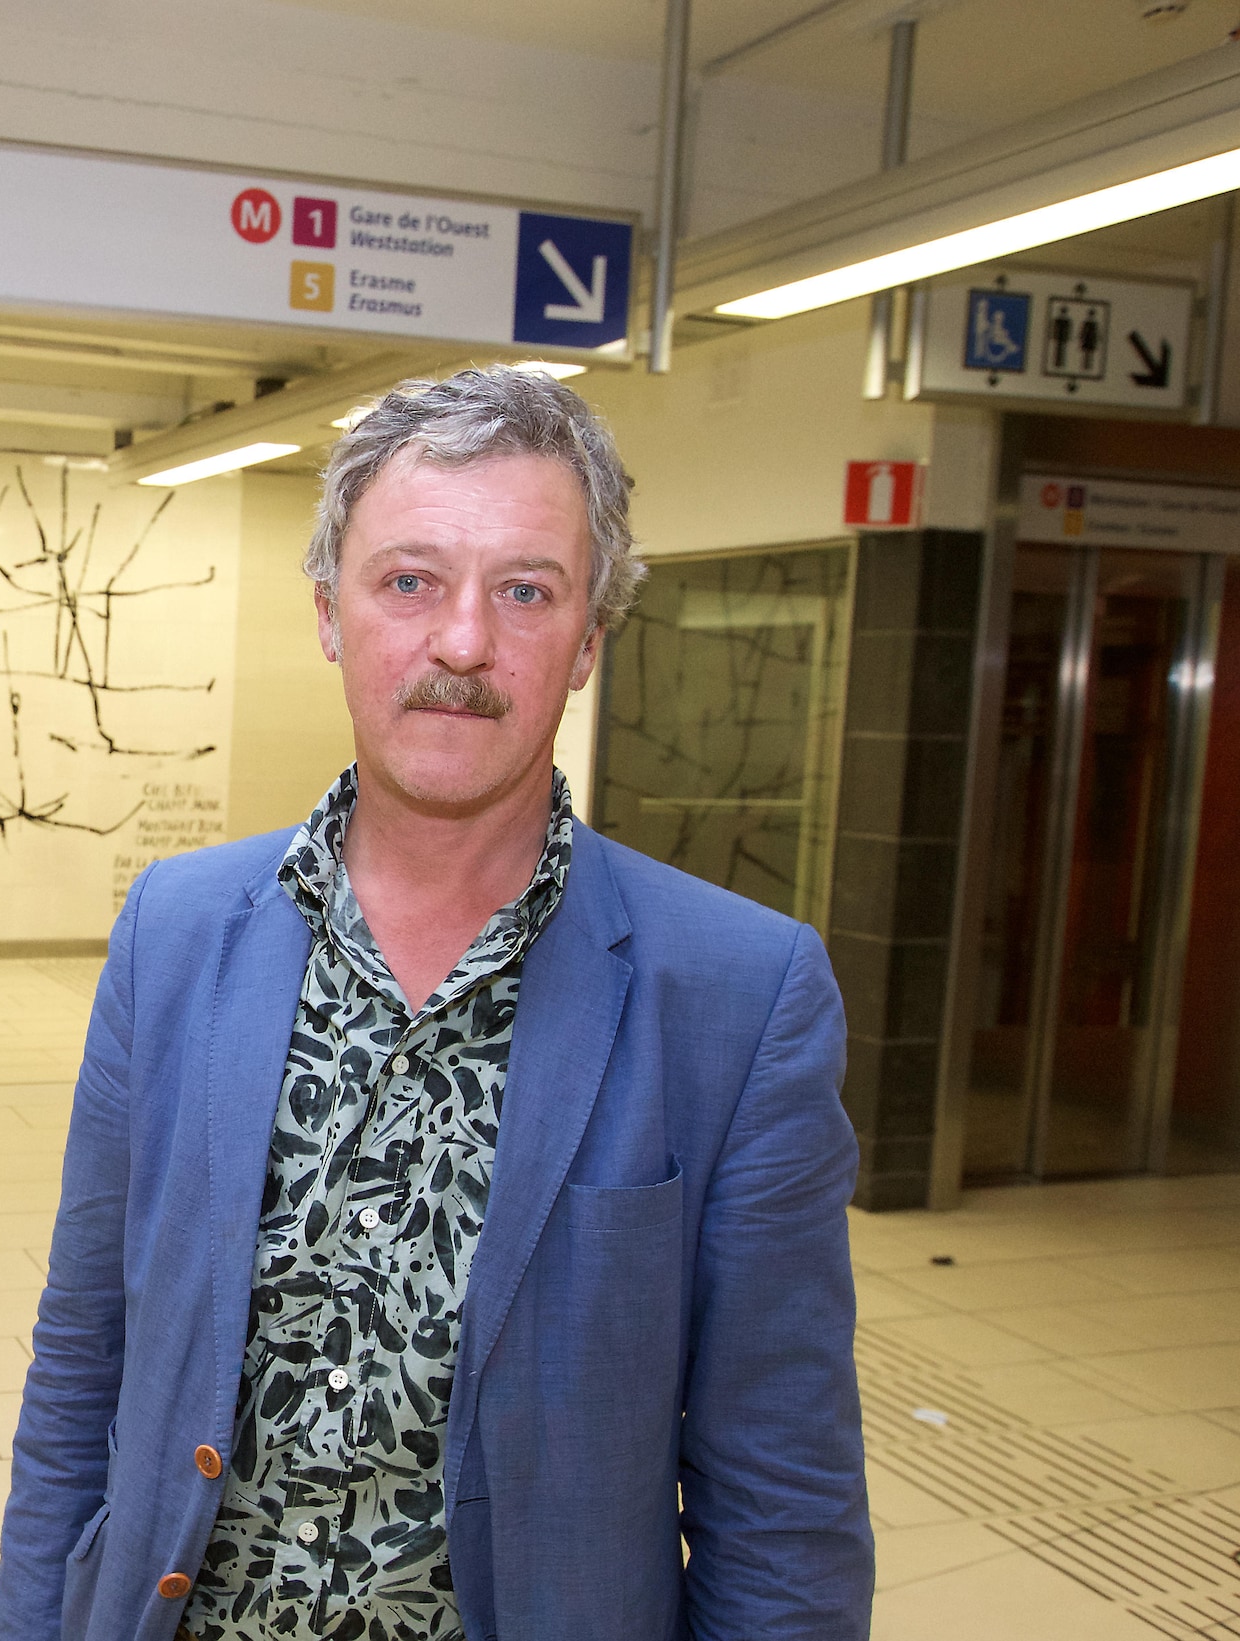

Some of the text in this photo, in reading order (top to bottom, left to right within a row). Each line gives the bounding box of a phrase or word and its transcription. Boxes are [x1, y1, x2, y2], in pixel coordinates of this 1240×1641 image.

[239, 198, 490, 239] M 1 Gare de l'Ouest
[350, 230, 454, 256] Weststation
[304, 269, 416, 300] 5 Erasme
[349, 293, 422, 317] Erasmus
